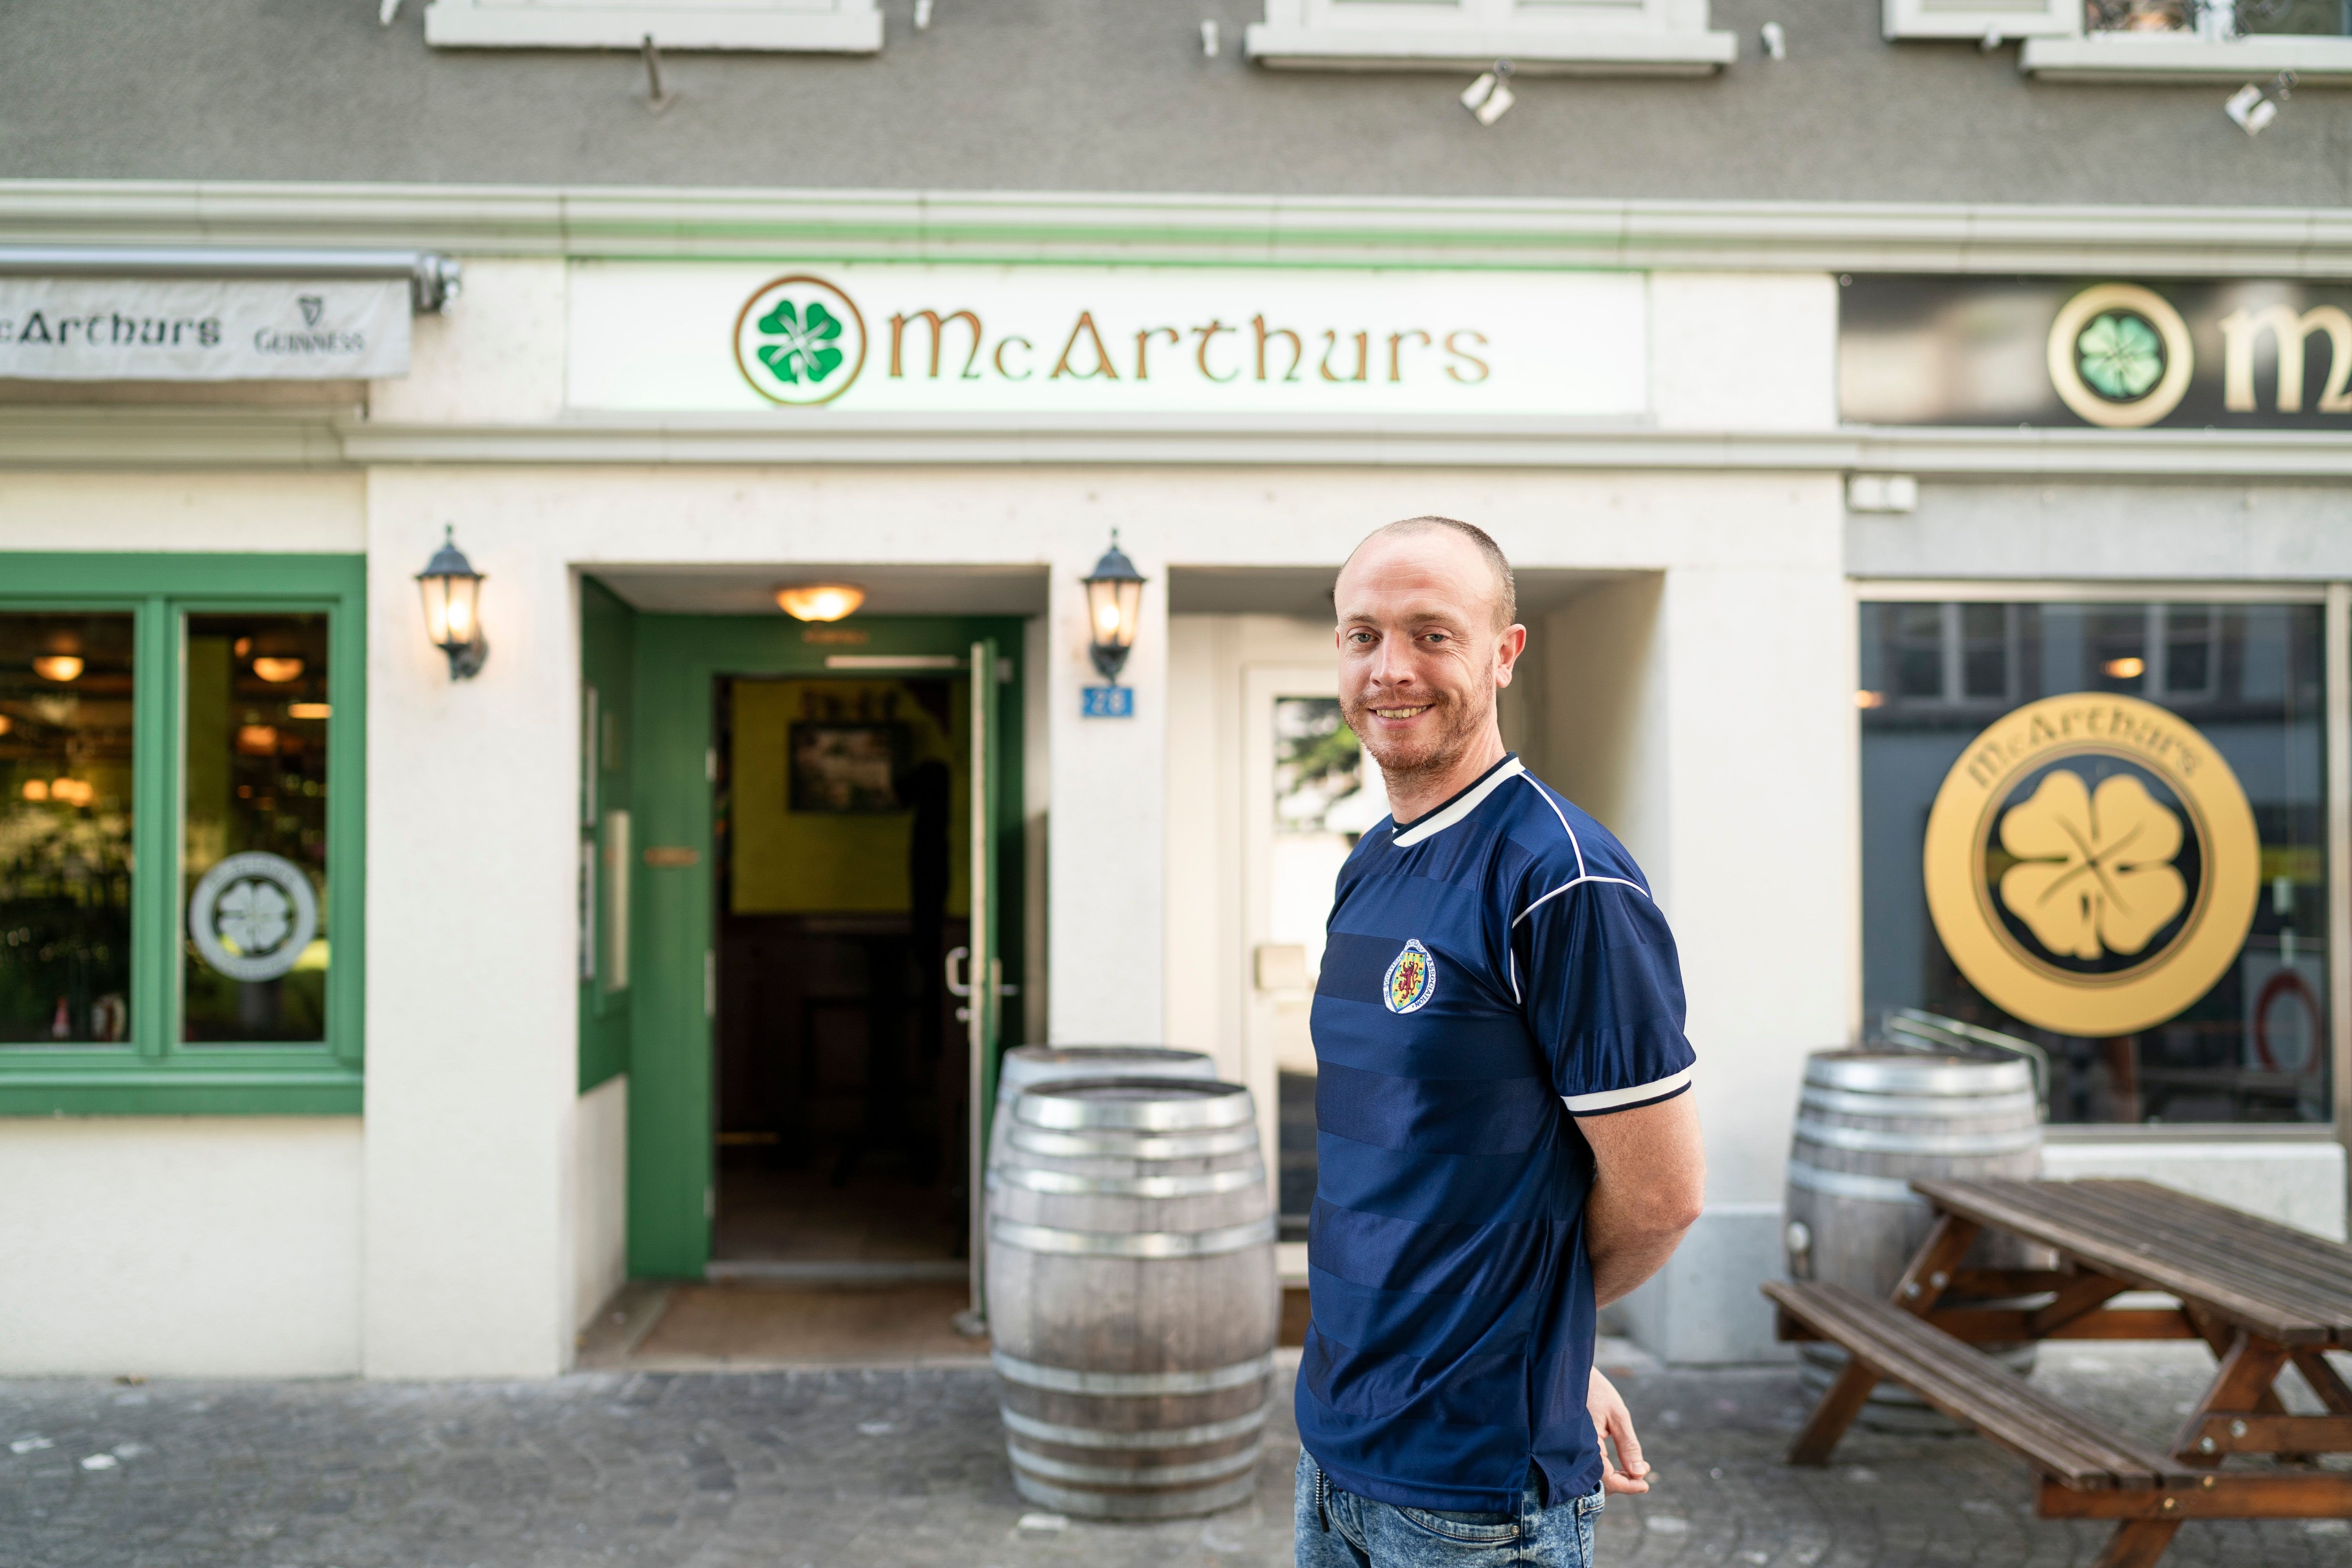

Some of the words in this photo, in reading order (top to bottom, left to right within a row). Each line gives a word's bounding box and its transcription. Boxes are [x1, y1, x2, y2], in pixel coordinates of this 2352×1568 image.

[254, 327, 365, 353] GUINNESS
[887, 307, 1490, 383] McArthurs
[1967, 706, 2202, 789] McArthurs
[1414, 960, 1435, 1007] ASSOCIATION
